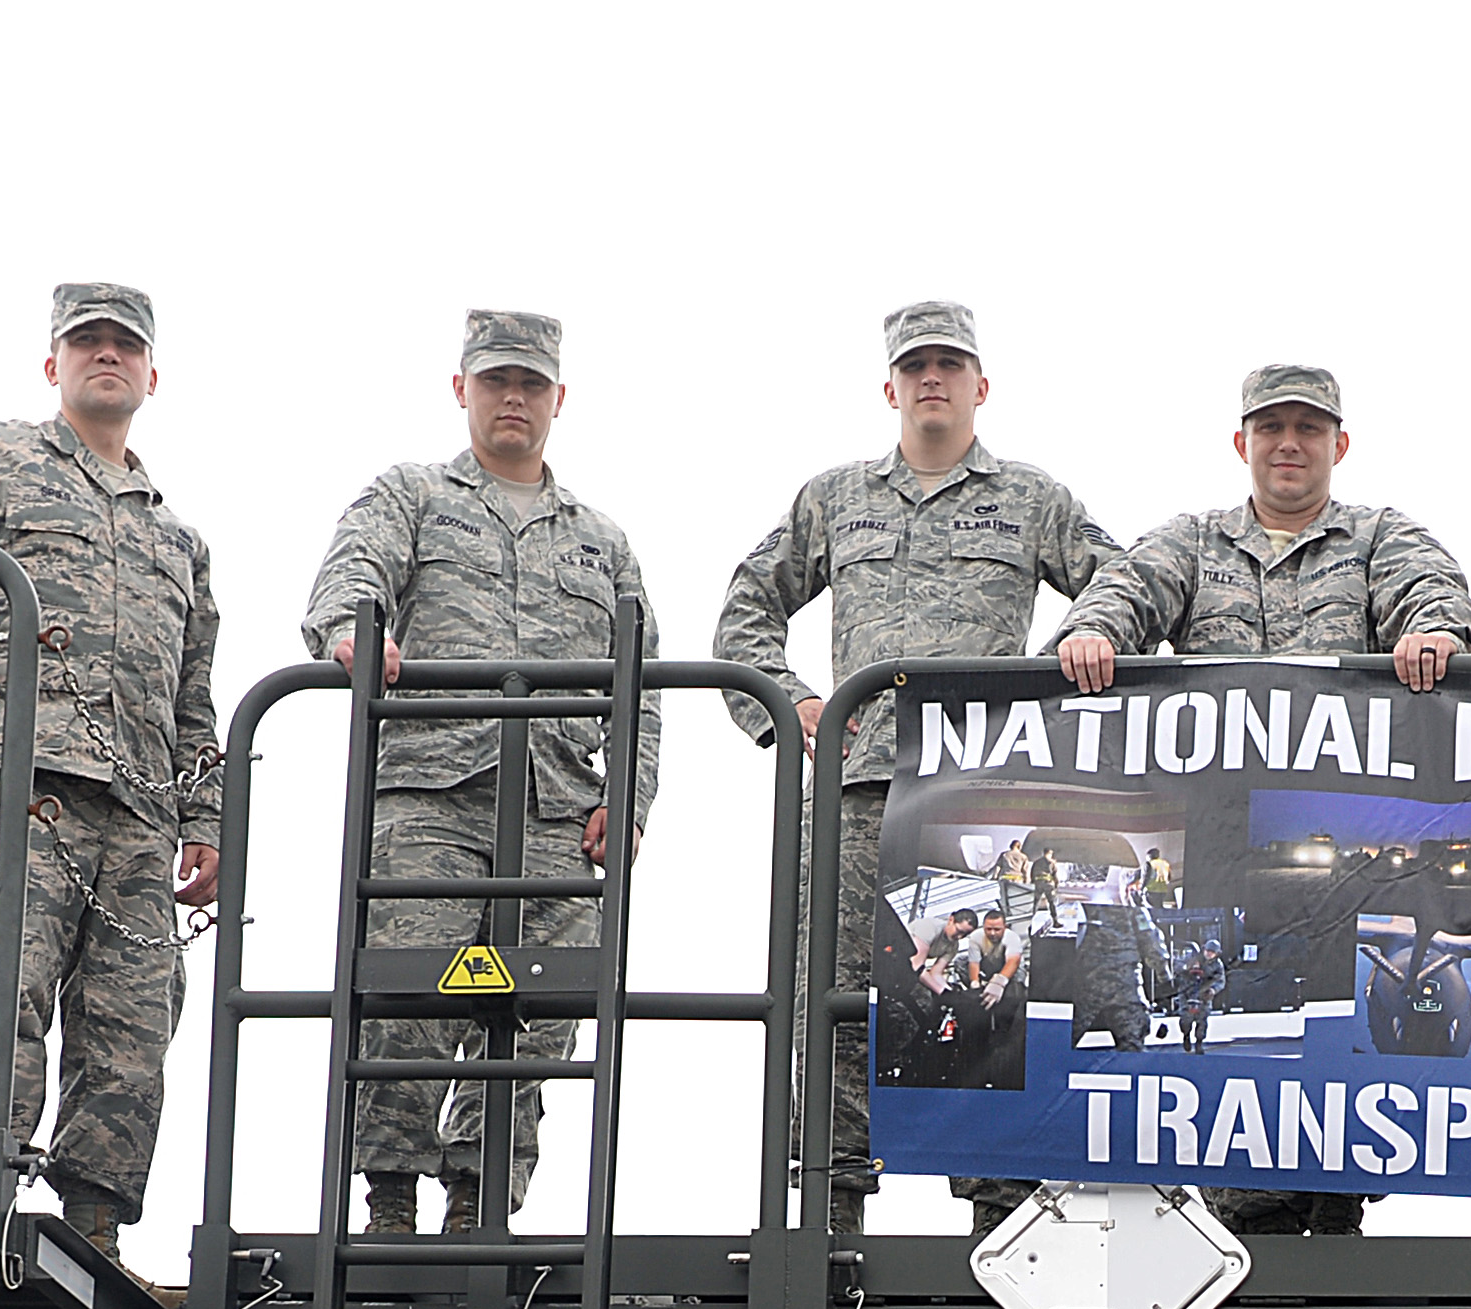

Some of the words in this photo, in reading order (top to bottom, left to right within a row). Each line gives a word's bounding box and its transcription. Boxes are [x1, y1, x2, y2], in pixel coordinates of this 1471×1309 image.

[436, 514, 482, 538] GOODMAN
[974, 520, 992, 530] AIR
[993, 520, 1021, 535] FORCE
[1202, 569, 1234, 584] TULLY
[919, 690, 1416, 780] NATIONAL
